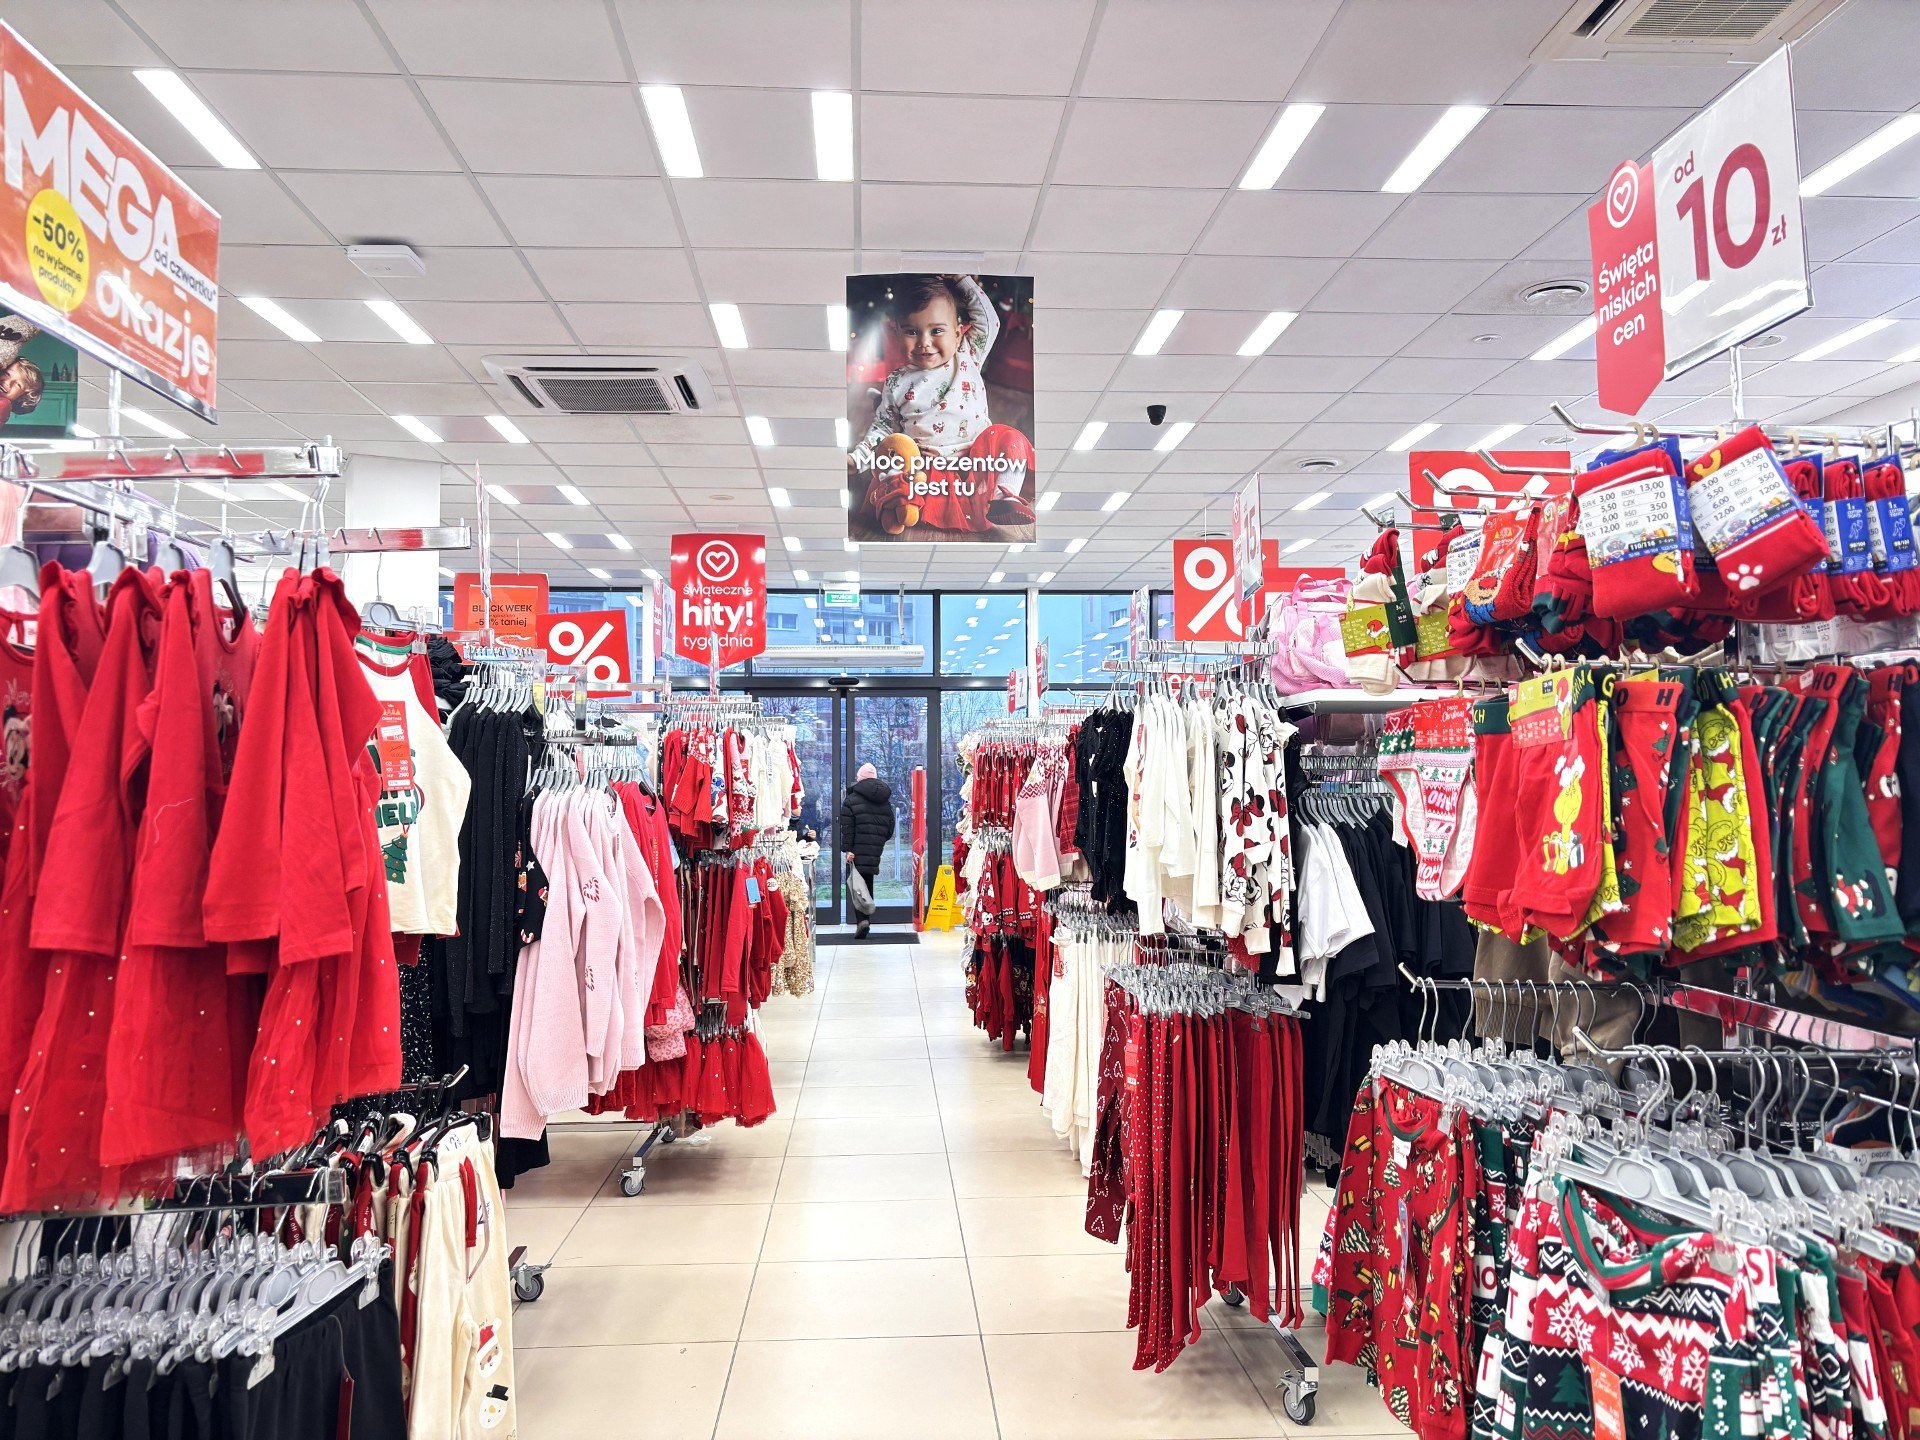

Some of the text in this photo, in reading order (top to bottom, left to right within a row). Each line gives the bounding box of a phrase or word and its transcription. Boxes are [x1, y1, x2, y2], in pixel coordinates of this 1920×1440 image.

[4, 70, 183, 276] MEGA
[1673, 150, 1696, 185] od
[1675, 142, 1788, 282] 10 zł
[32, 212, 84, 263] -50%
[33, 245, 82, 283] na wybrane
[153, 248, 168, 268] od
[1598, 240, 1655, 295] Święta
[38, 265, 77, 298] produkty
[1598, 274, 1657, 326] niskich
[95, 267, 210, 378] okazje
[1612, 312, 1646, 347] cen
[855, 451, 1027, 475] Moc prezentów
[1701, 476, 1719, 491] 3,00
[1723, 467, 1738, 477] RON
[1740, 452, 1764, 468] 13,00
[907, 477, 975, 499] jest tu
[1599, 492, 1616, 503] 3,00
[1640, 480, 1664, 493] 13,00
[1707, 486, 1724, 500] 5,50
[1729, 478, 1742, 487] CZK
[1757, 462, 1769, 472] 70
[1712, 495, 1730, 510] 6,00
[1734, 486, 1748, 496] RSD
[1758, 472, 1775, 484] 350
[1601, 502, 1617, 513] 5,50
[1654, 491, 1666, 500] 70
[1602, 512, 1619, 523] 6,00
[1650, 501, 1668, 512] 350
[1713, 505, 1736, 522] 12,00
[1758, 481, 1781, 496] 1200
[1599, 522, 1620, 535] 12,00
[1625, 520, 1639, 528] HUF
[1646, 512, 1669, 523] 1200
[1629, 540, 1656, 550] 110/116
[682, 584, 753, 597] świąteczne
[472, 604, 533, 613] BLCK WEEK
[475, 617, 527, 628] -5% taniej
[682, 597, 754, 633] hity!
